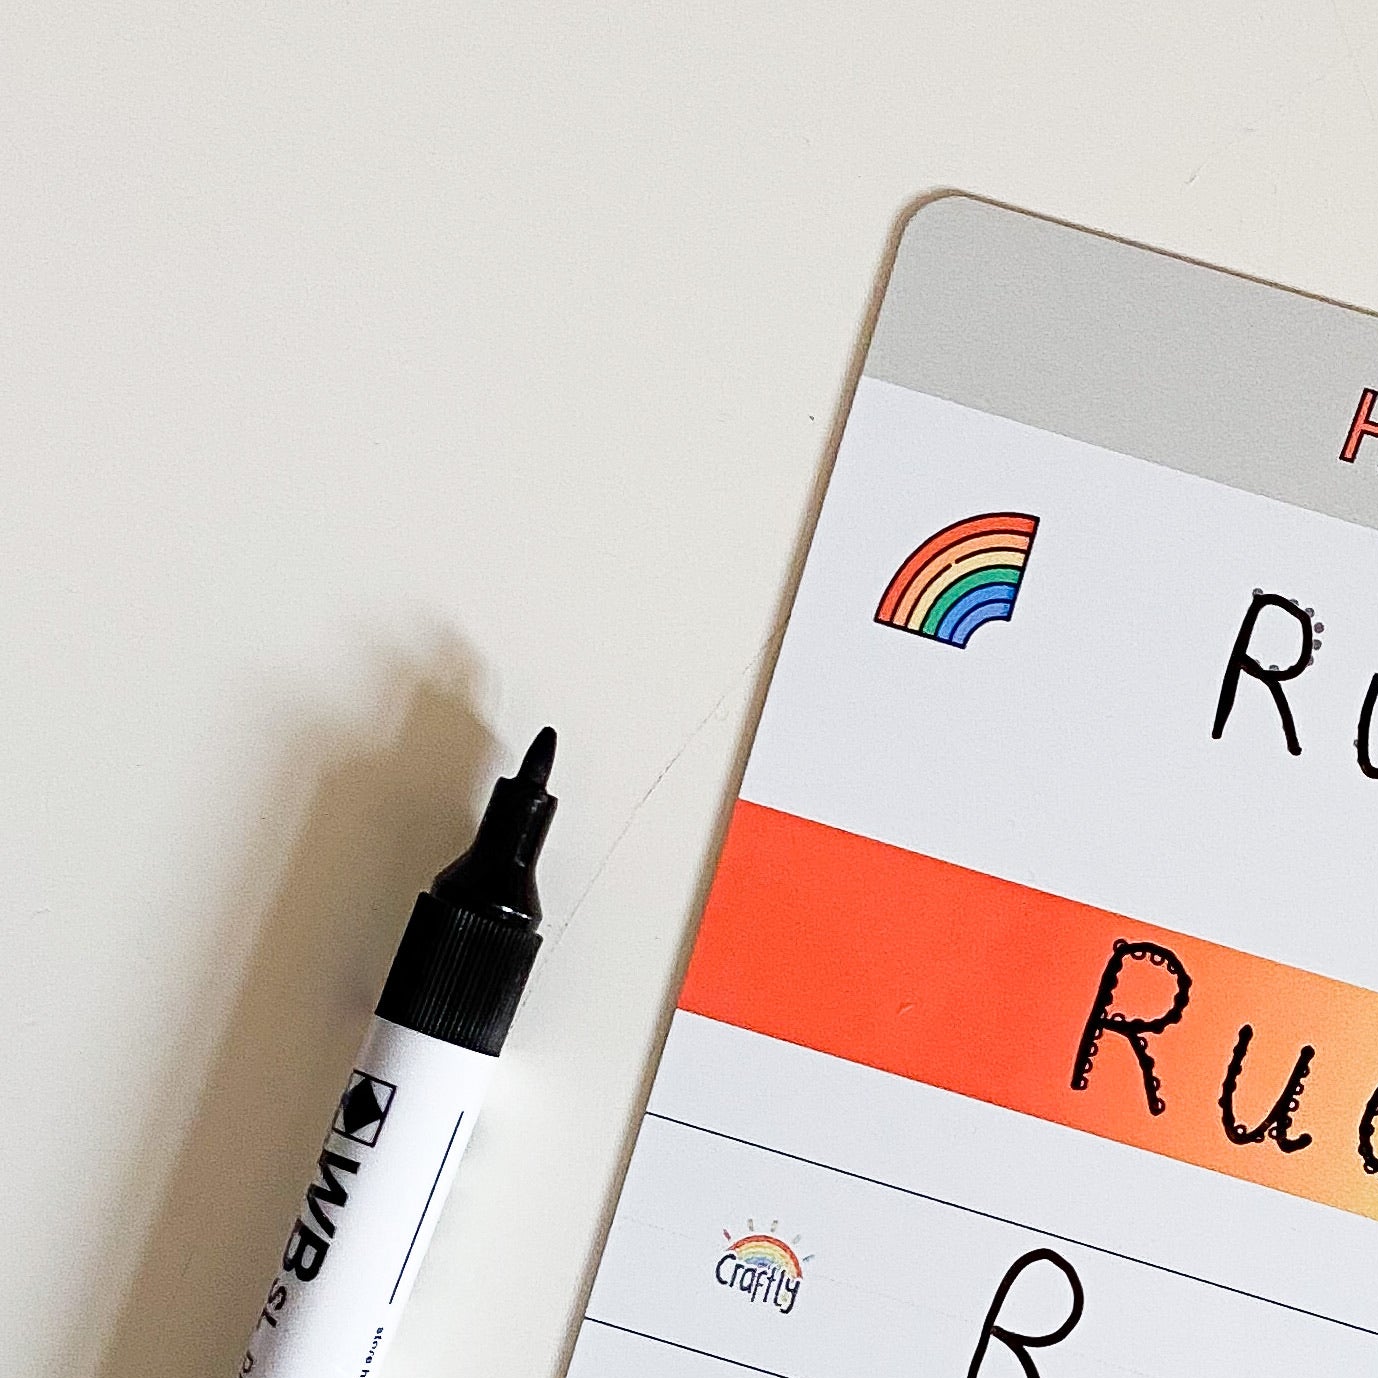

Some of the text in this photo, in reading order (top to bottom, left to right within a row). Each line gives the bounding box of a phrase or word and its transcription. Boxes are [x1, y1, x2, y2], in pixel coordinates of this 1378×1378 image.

[282, 1149, 361, 1282] WB
[715, 1253, 801, 1315] Craftly
[365, 1327, 384, 1365] store
